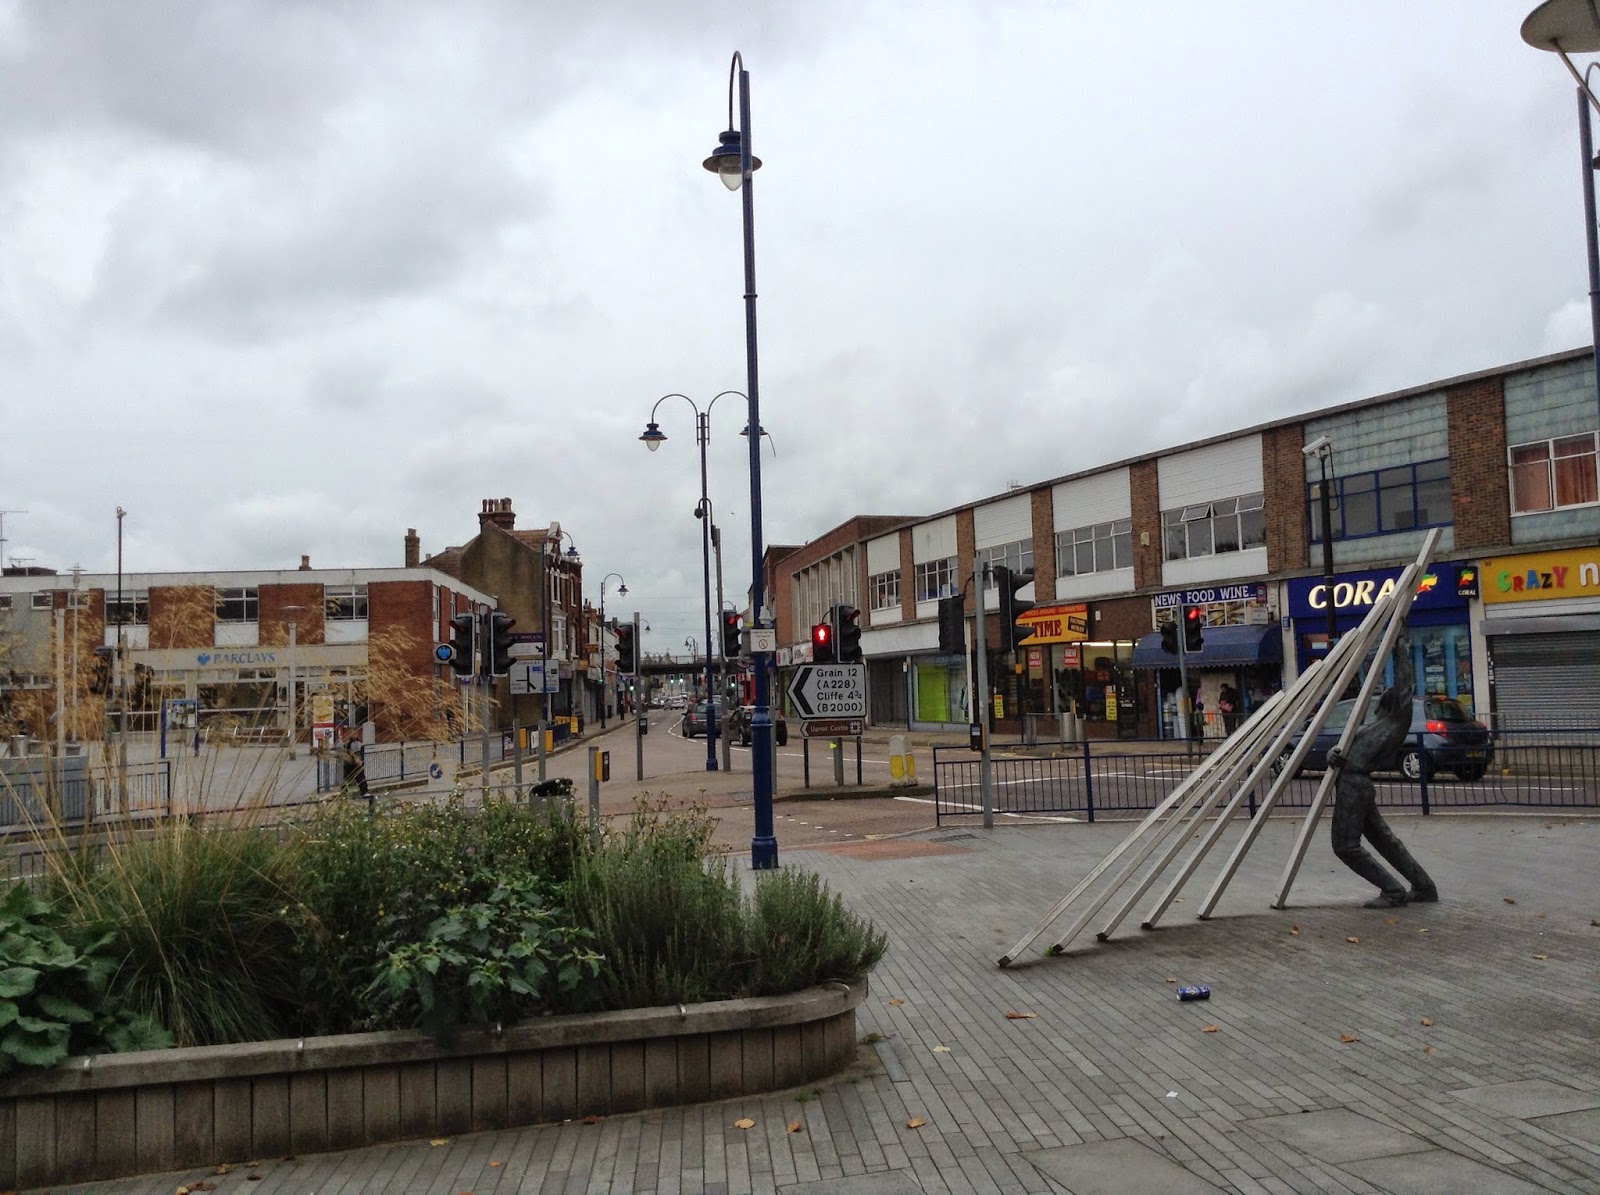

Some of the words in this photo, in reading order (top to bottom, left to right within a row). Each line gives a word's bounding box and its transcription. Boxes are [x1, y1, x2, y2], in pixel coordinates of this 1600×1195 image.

[1497, 566, 1568, 592] CRAZY
[1154, 593, 1182, 607] NEWS
[1186, 589, 1216, 603] FOOD
[1220, 585, 1250, 600] WINE
[1308, 577, 1418, 609] CORA
[1457, 588, 1477, 596] CORAL
[1032, 619, 1062, 638] TIME
[816, 668, 843, 677] Grain
[847, 668, 858, 677] 12
[816, 679, 856, 690] (A228)
[816, 691, 844, 701] Cliffe
[817, 702, 863, 713] (B2000)
[829, 724, 849, 732] Castle
